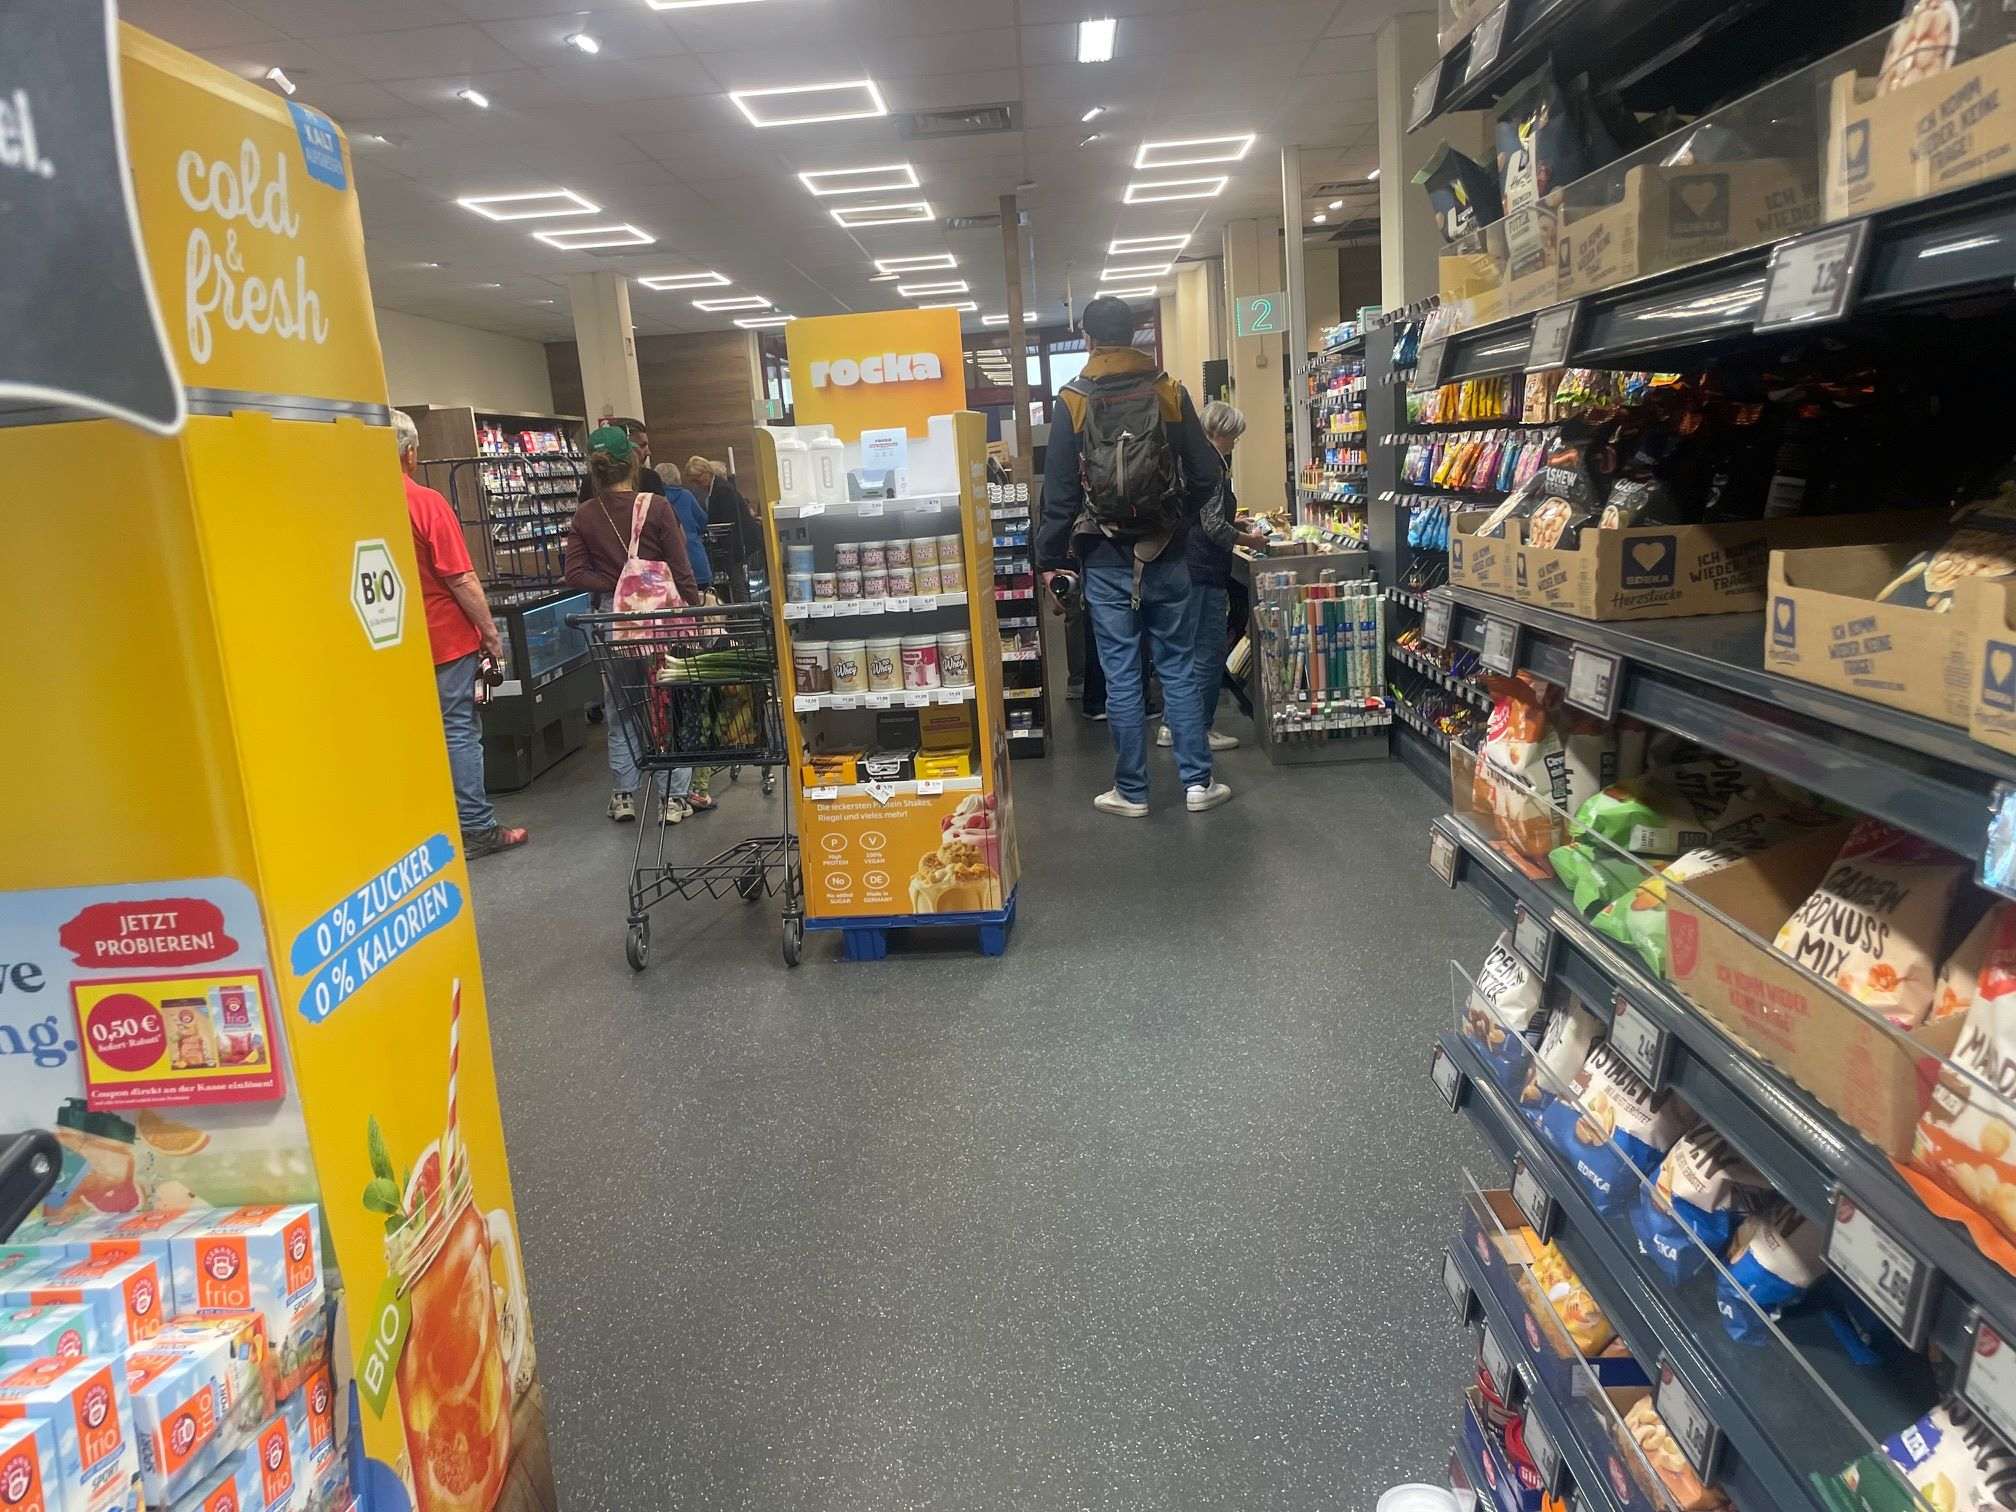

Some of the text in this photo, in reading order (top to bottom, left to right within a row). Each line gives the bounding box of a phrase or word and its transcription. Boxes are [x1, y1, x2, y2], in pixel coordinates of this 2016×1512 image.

[176, 137, 299, 239] cold
[225, 228, 245, 274] &
[183, 228, 329, 364] fresh
[1250, 298, 1273, 332] 2
[810, 352, 943, 389] rocka
[831, 836, 878, 848] P V
[831, 877, 845, 886] No
[869, 875, 883, 884] DE
[316, 844, 434, 957] 0 % ZUCKER
[119, 911, 179, 936] JETZT
[95, 931, 216, 957] PROBIEREN!
[315, 879, 449, 1016] 0 % KALORIEN
[1795, 930, 1850, 979] MIX
[91, 1013, 160, 1042] 0,50 €
[91, 1089, 129, 1100] Coupon
[131, 1086, 162, 1096] direkt
[178, 1084, 196, 1094] der
[197, 1082, 227, 1092] Kasse
[1576, 1159, 1611, 1194] EDEKA
[205, 1279, 245, 1306] frio
[289, 1264, 313, 1289] frio
[364, 1303, 400, 1396] BIO
[83, 1427, 118, 1465] frio
[267, 1471, 290, 1502] frio
